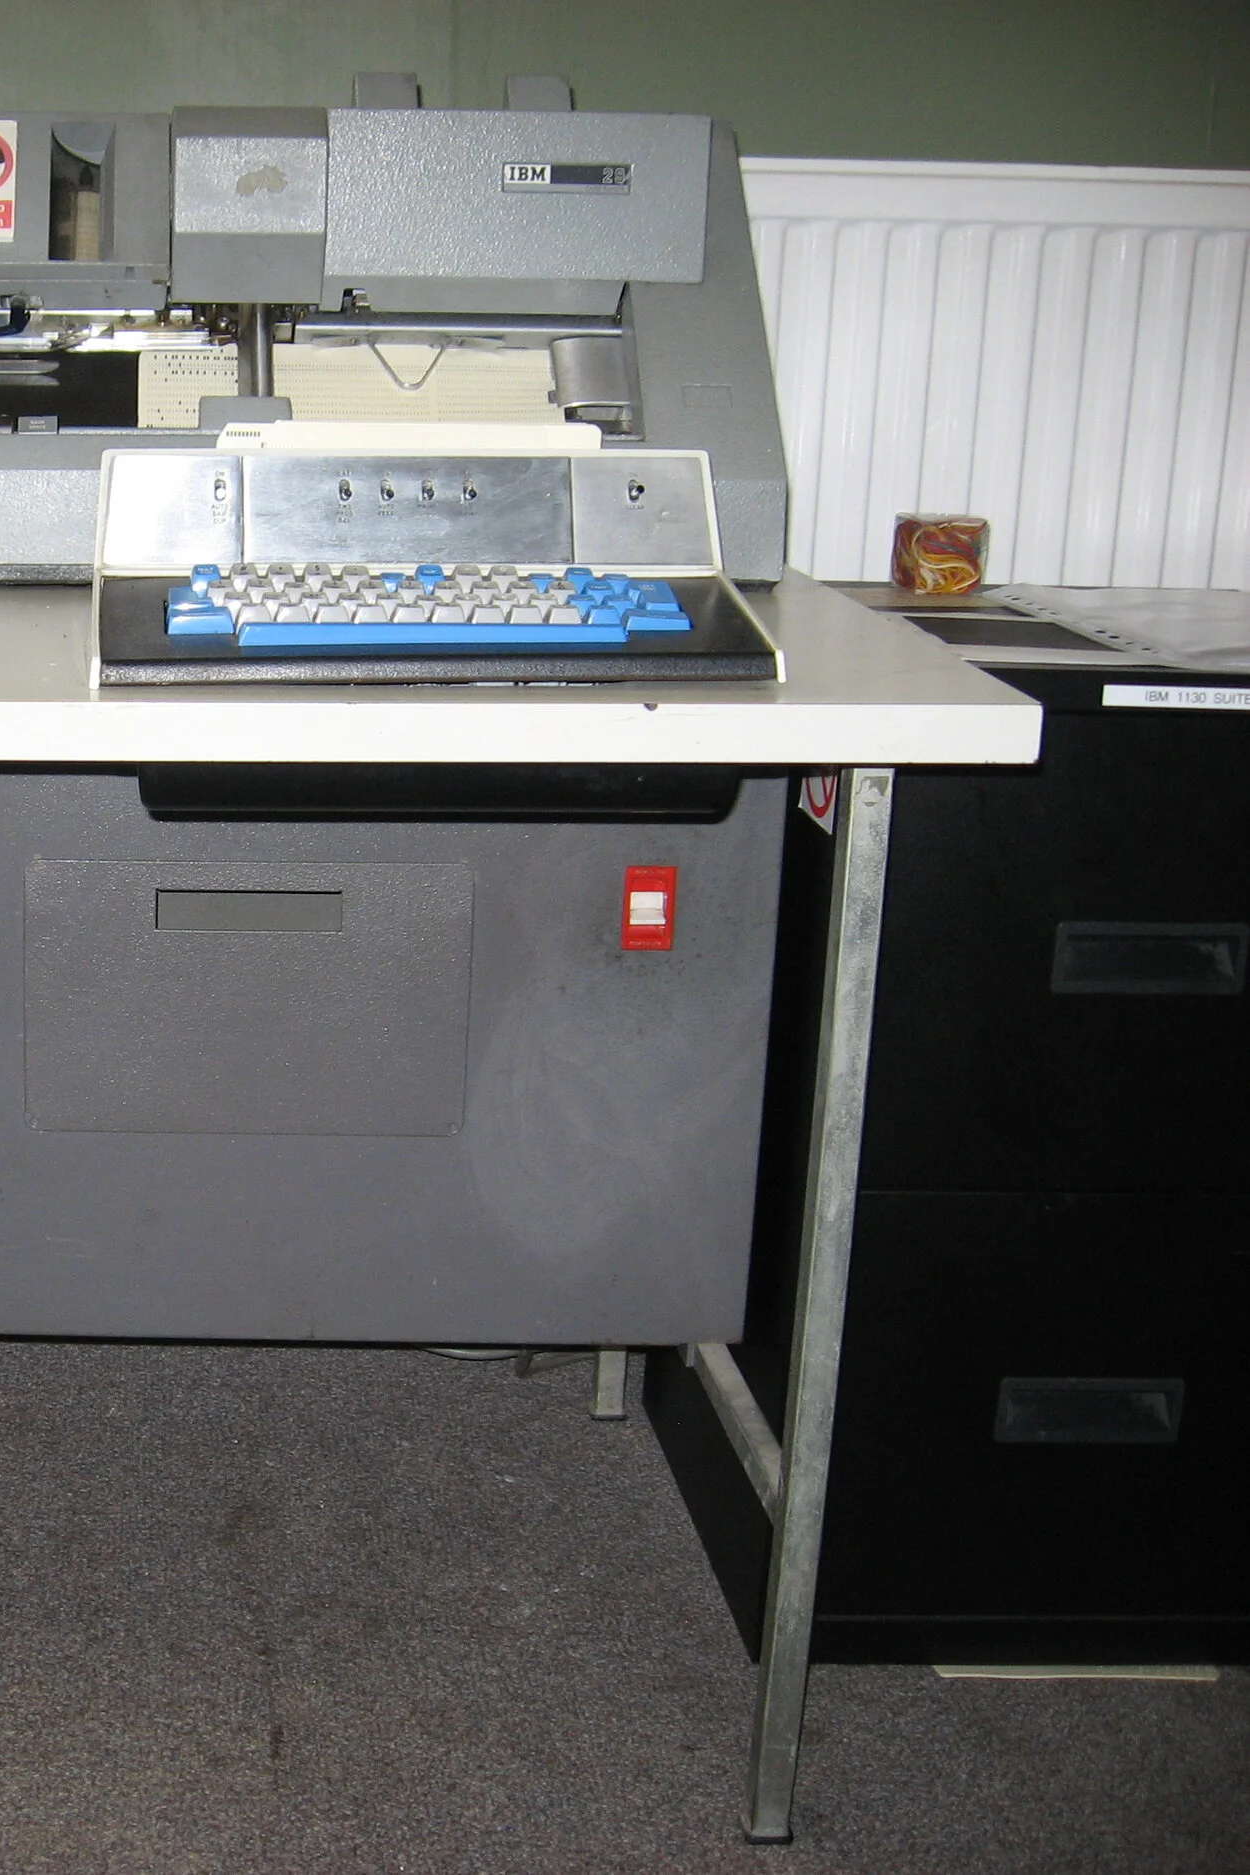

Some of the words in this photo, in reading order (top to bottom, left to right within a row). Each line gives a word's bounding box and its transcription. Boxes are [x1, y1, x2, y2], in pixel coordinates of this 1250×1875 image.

[509, 166, 547, 181] IBM
[601, 167, 627, 185] 29
[1144, 691, 1169, 702] IBM
[1177, 692, 1207, 704] 1130
[1213, 692, 1250, 705] SUITE
